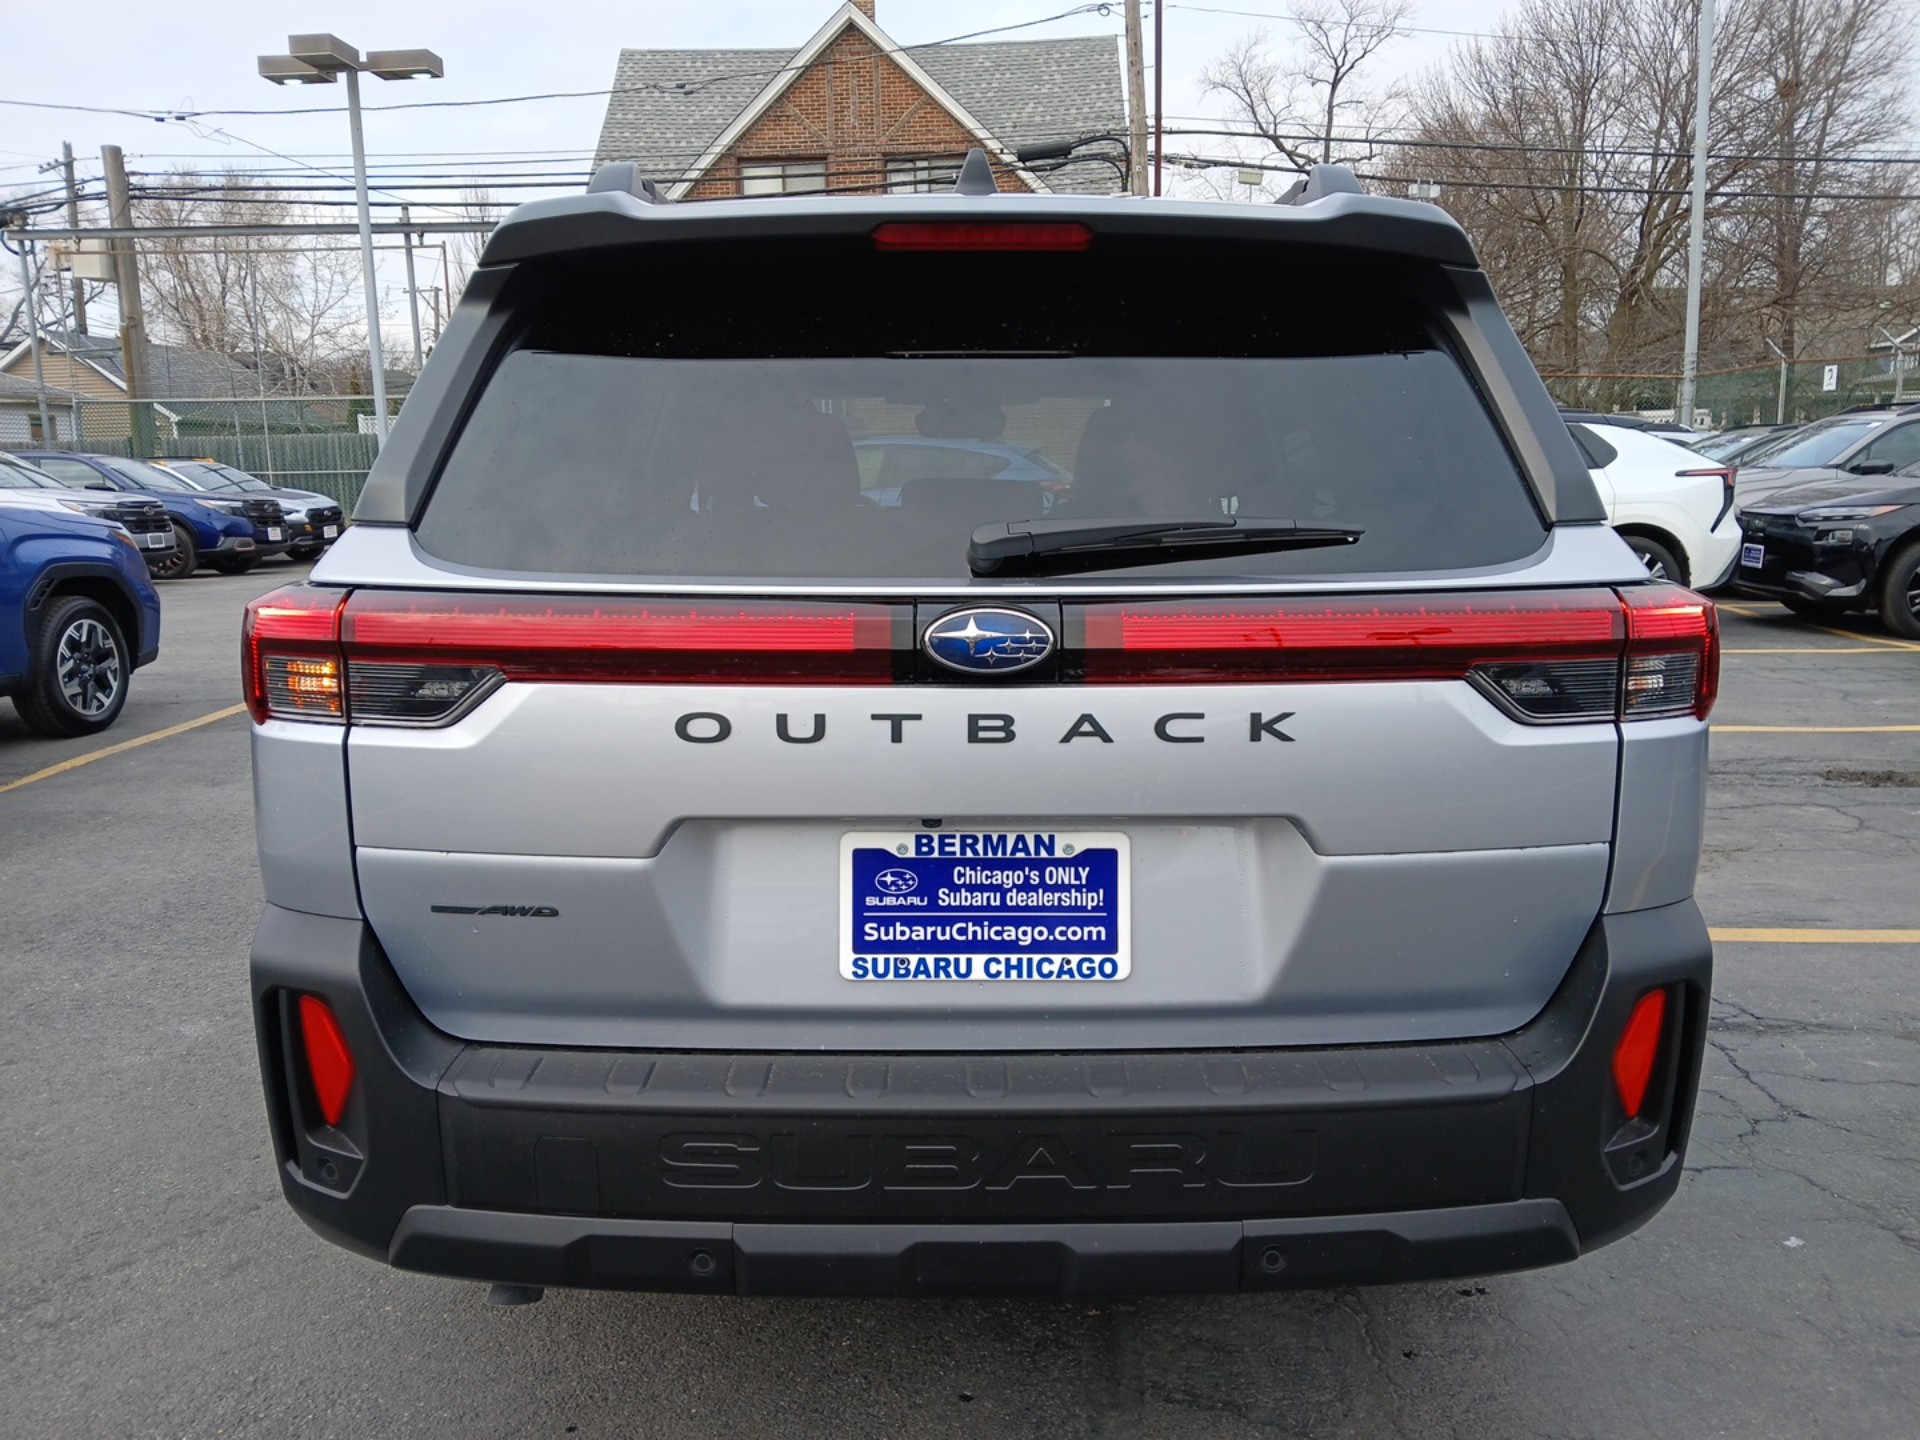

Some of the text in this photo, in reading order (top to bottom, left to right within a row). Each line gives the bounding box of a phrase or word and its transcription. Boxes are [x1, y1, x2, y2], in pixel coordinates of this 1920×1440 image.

[674, 712, 1297, 744] OUTBACK
[914, 834, 1056, 857] BERMAN
[953, 866, 1090, 889] Chicago's ONLY
[865, 896, 928, 907] SUBARU
[938, 888, 1104, 910] Subaru dealership!
[478, 905, 560, 918] AWD
[863, 922, 1107, 946] SubaruChicago.com
[851, 957, 1119, 980] SUBARU CHICAGO
[659, 1130, 1318, 1191] SUBARU
